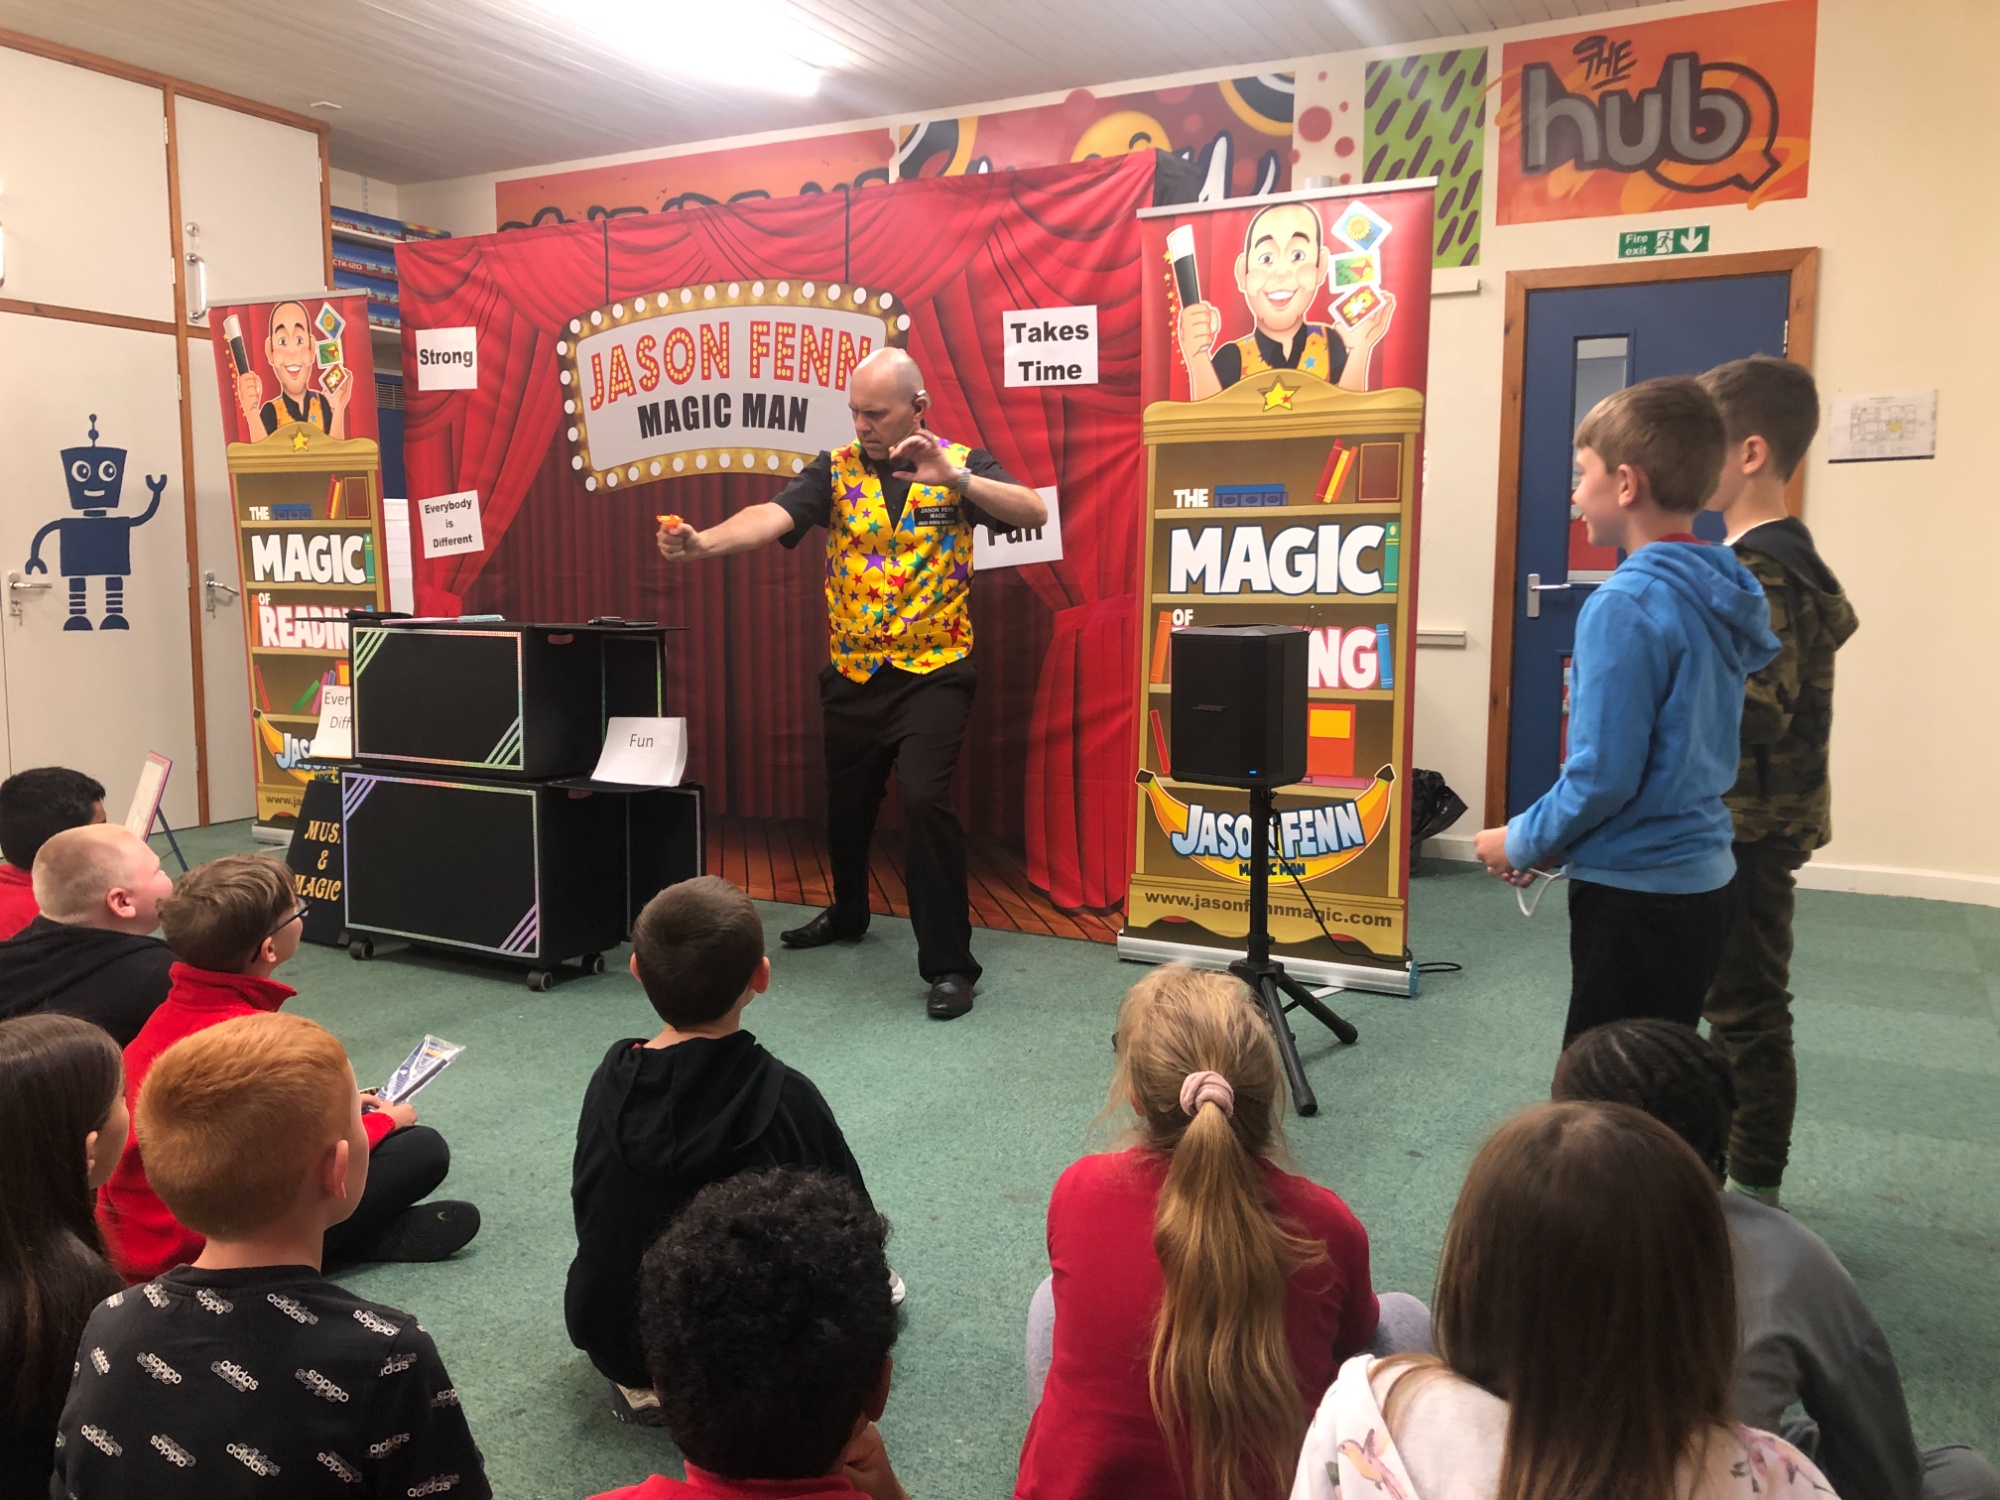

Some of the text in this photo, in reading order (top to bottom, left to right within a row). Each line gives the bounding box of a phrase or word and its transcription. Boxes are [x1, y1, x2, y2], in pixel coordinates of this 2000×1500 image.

[1572, 35, 1637, 82] THE
[1625, 233, 1648, 244] Fire
[1625, 244, 1647, 256] exit
[1010, 321, 1090, 344] Takes
[419, 349, 474, 368] Strong
[589, 321, 872, 412] JASON FENN
[1018, 360, 1083, 382] Time
[637, 393, 809, 439] MAGIC MAN
[424, 498, 473, 515] Everybody
[1173, 488, 1209, 508] THE
[249, 506, 270, 521] THE
[445, 519, 454, 529] is
[432, 533, 473, 549] Different
[251, 533, 367, 585] MAGIC
[1169, 523, 1386, 595] MAGIC
[258, 593, 271, 605] OF
[258, 604, 367, 651] READIN
[1172, 609, 1194, 626] OF
[324, 692, 350, 706] Ever
[329, 716, 351, 730] Diff
[629, 733, 654, 748] Fun
[275, 732, 332, 770] JAS
[304, 820, 341, 844] MUS
[1280, 800, 1367, 860] FENN
[317, 849, 329, 870] &
[1145, 892, 1392, 928] www.jasonfnmagic.com
